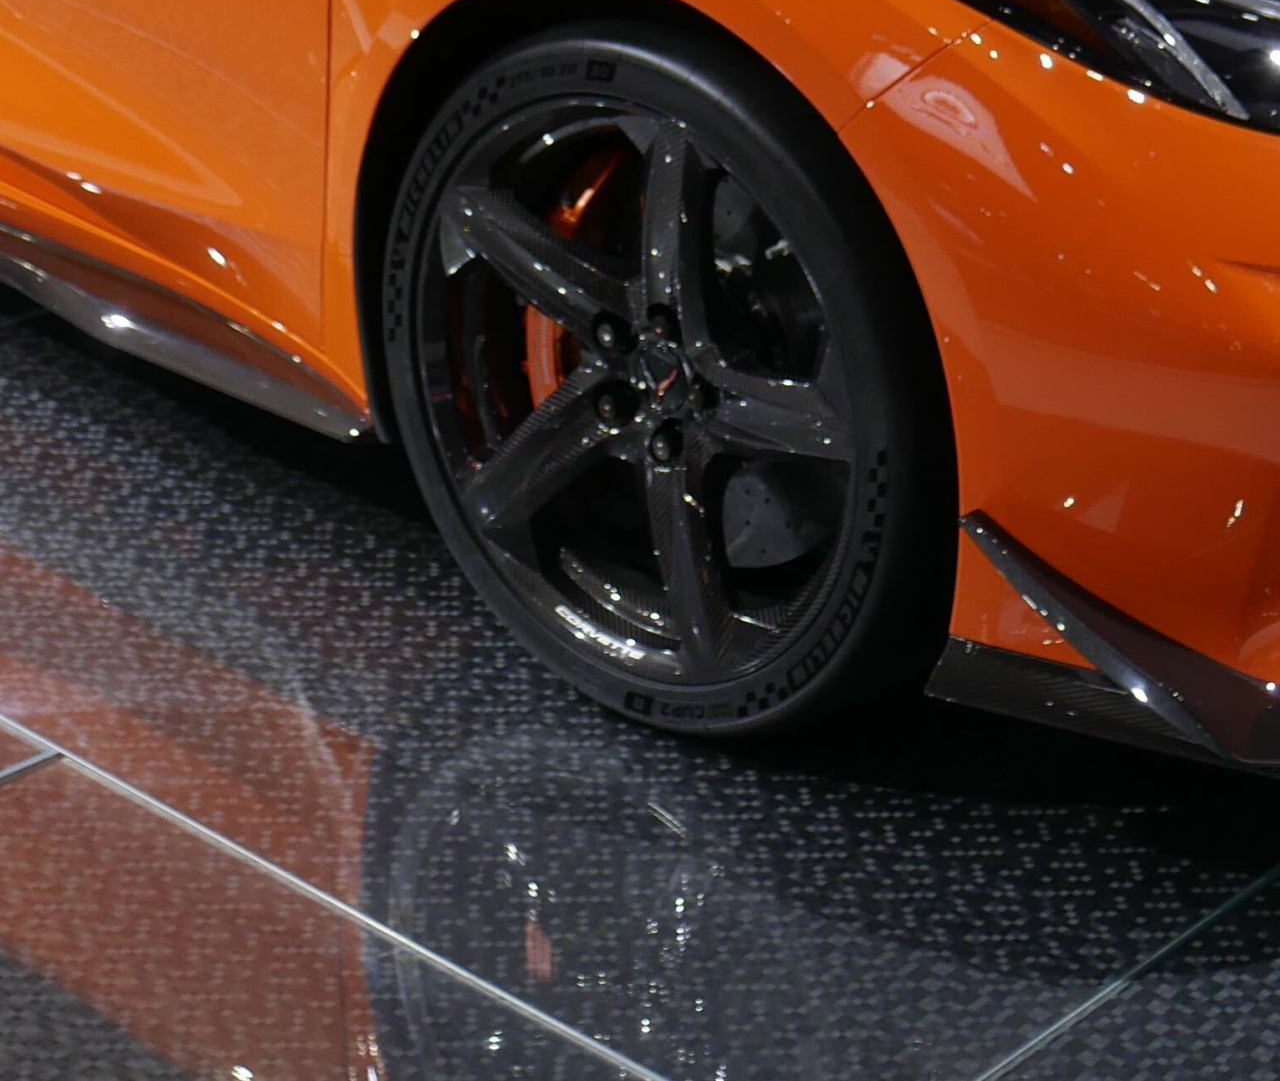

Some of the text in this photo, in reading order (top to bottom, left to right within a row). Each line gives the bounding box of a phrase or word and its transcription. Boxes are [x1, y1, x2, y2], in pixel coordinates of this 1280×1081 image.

[396, 109, 464, 243] MICHELIN
[554, 604, 647, 660] CORVETTE
[785, 561, 875, 693] MICHELIN
